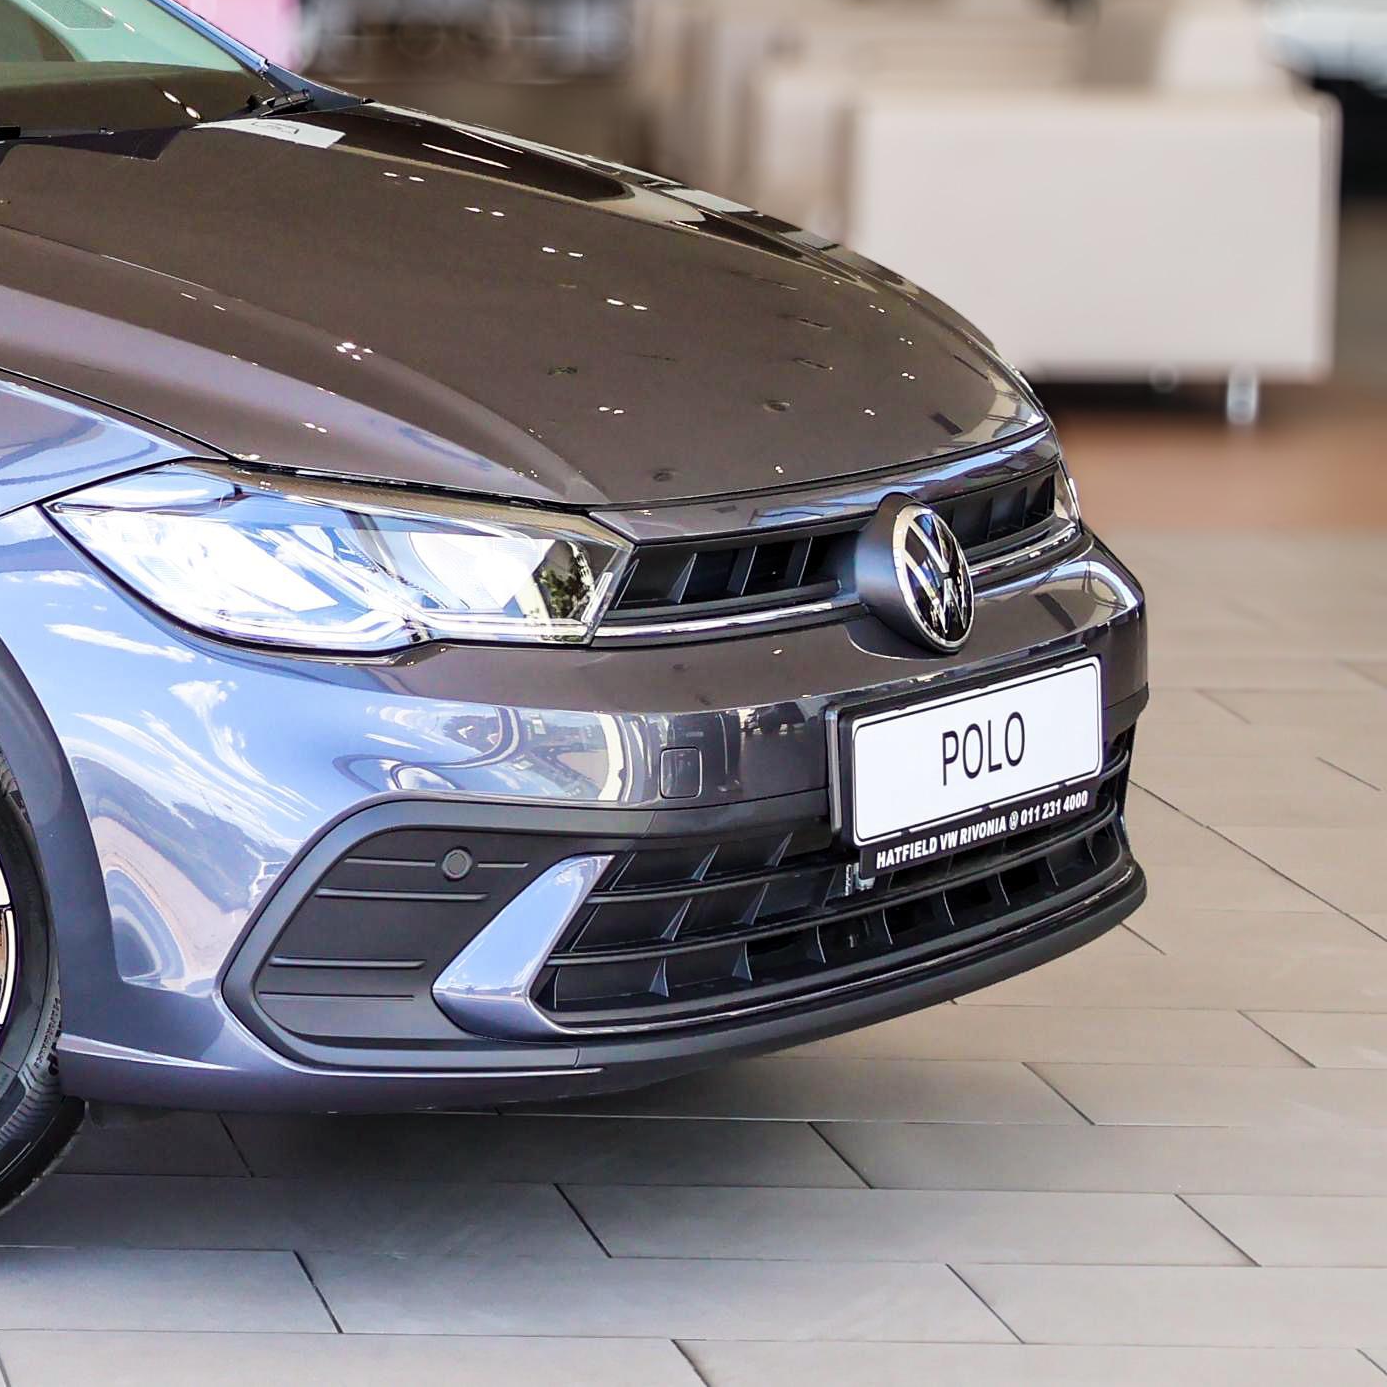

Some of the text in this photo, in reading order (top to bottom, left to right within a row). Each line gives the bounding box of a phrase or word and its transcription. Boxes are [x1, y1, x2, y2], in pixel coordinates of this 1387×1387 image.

[942, 711, 1025, 786] POLO
[876, 836, 938, 870] HATFIELD
[940, 830, 959, 851] VW
[959, 816, 1007, 845] RIVONIA
[1020, 804, 1040, 826] 011
[1041, 798, 1062, 820] 231
[1062, 790, 1089, 812] 4000
